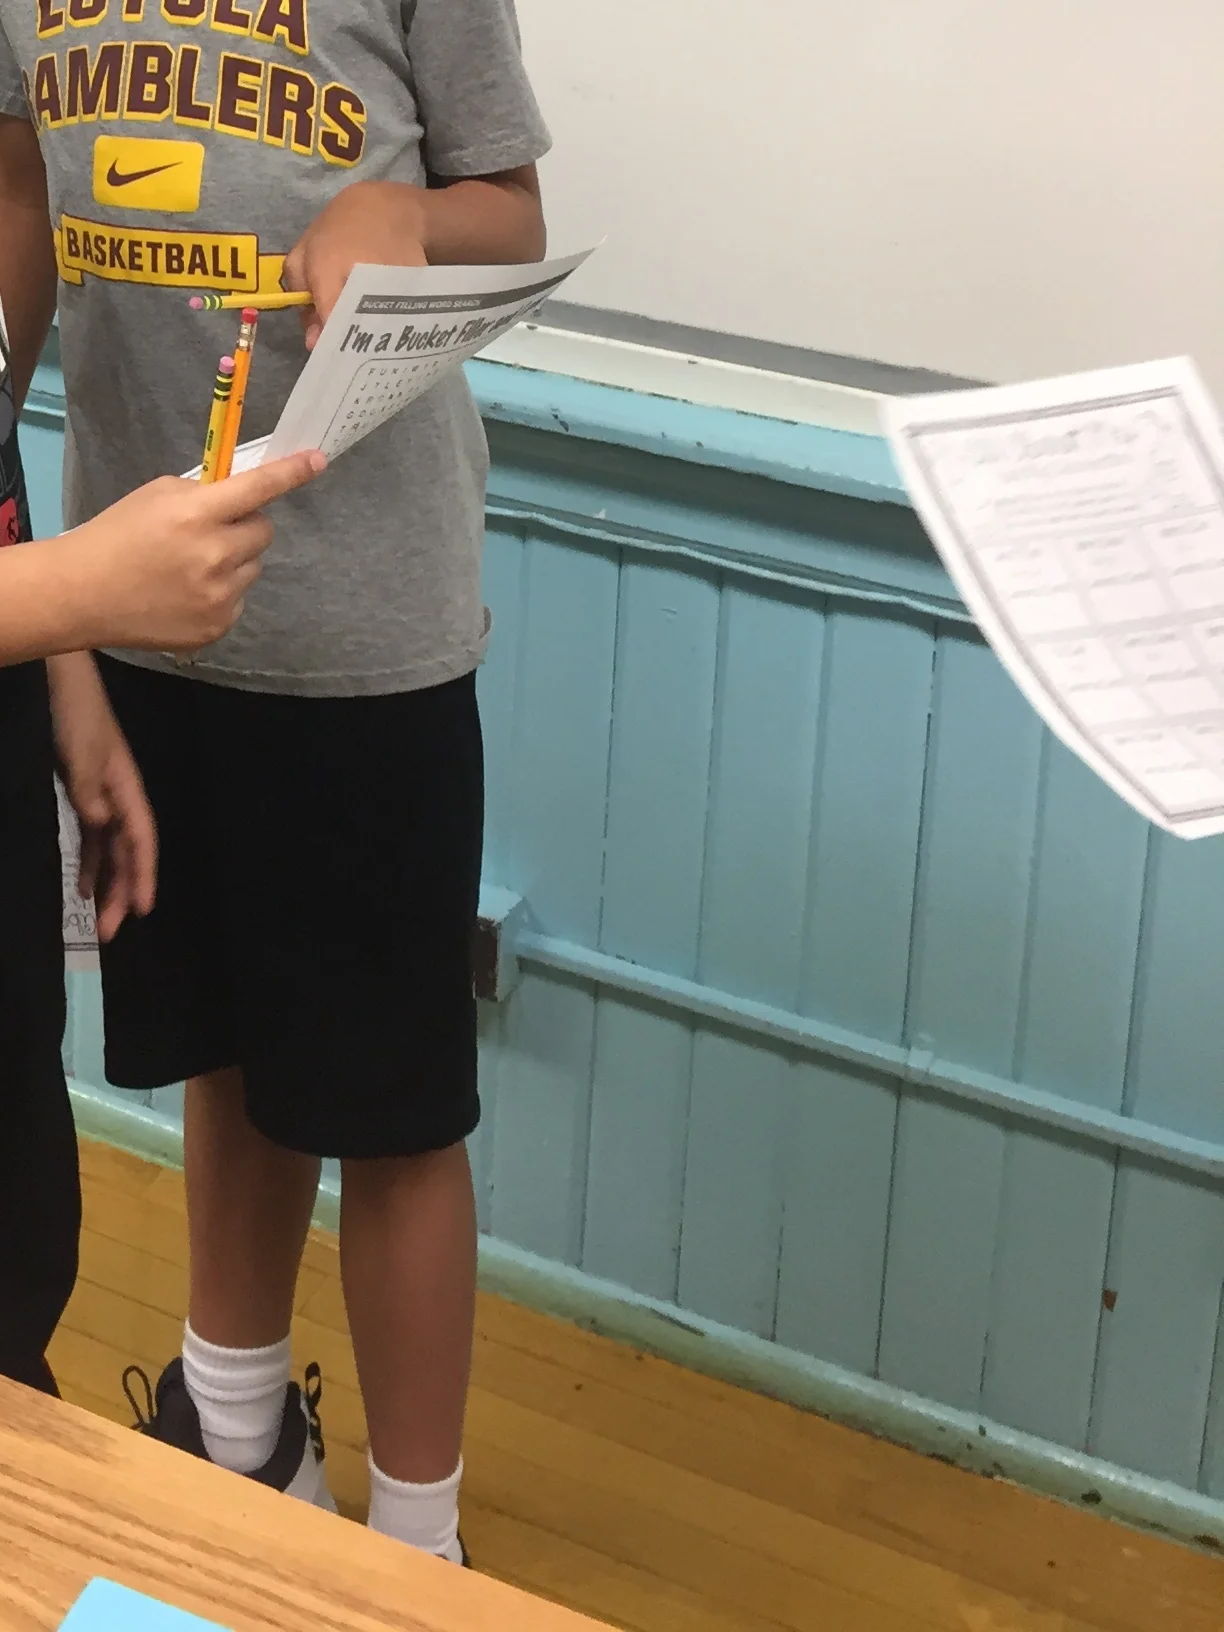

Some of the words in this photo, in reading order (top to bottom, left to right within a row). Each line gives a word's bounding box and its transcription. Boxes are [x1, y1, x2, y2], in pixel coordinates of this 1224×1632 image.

[23, 40, 368, 168] AMBLERS
[66, 226, 248, 280] BASKETBALL
[361, 299, 394, 309] BUCKET
[339, 323, 374, 353] I'm
[374, 332, 393, 353] a
[394, 323, 458, 353] Bucket
